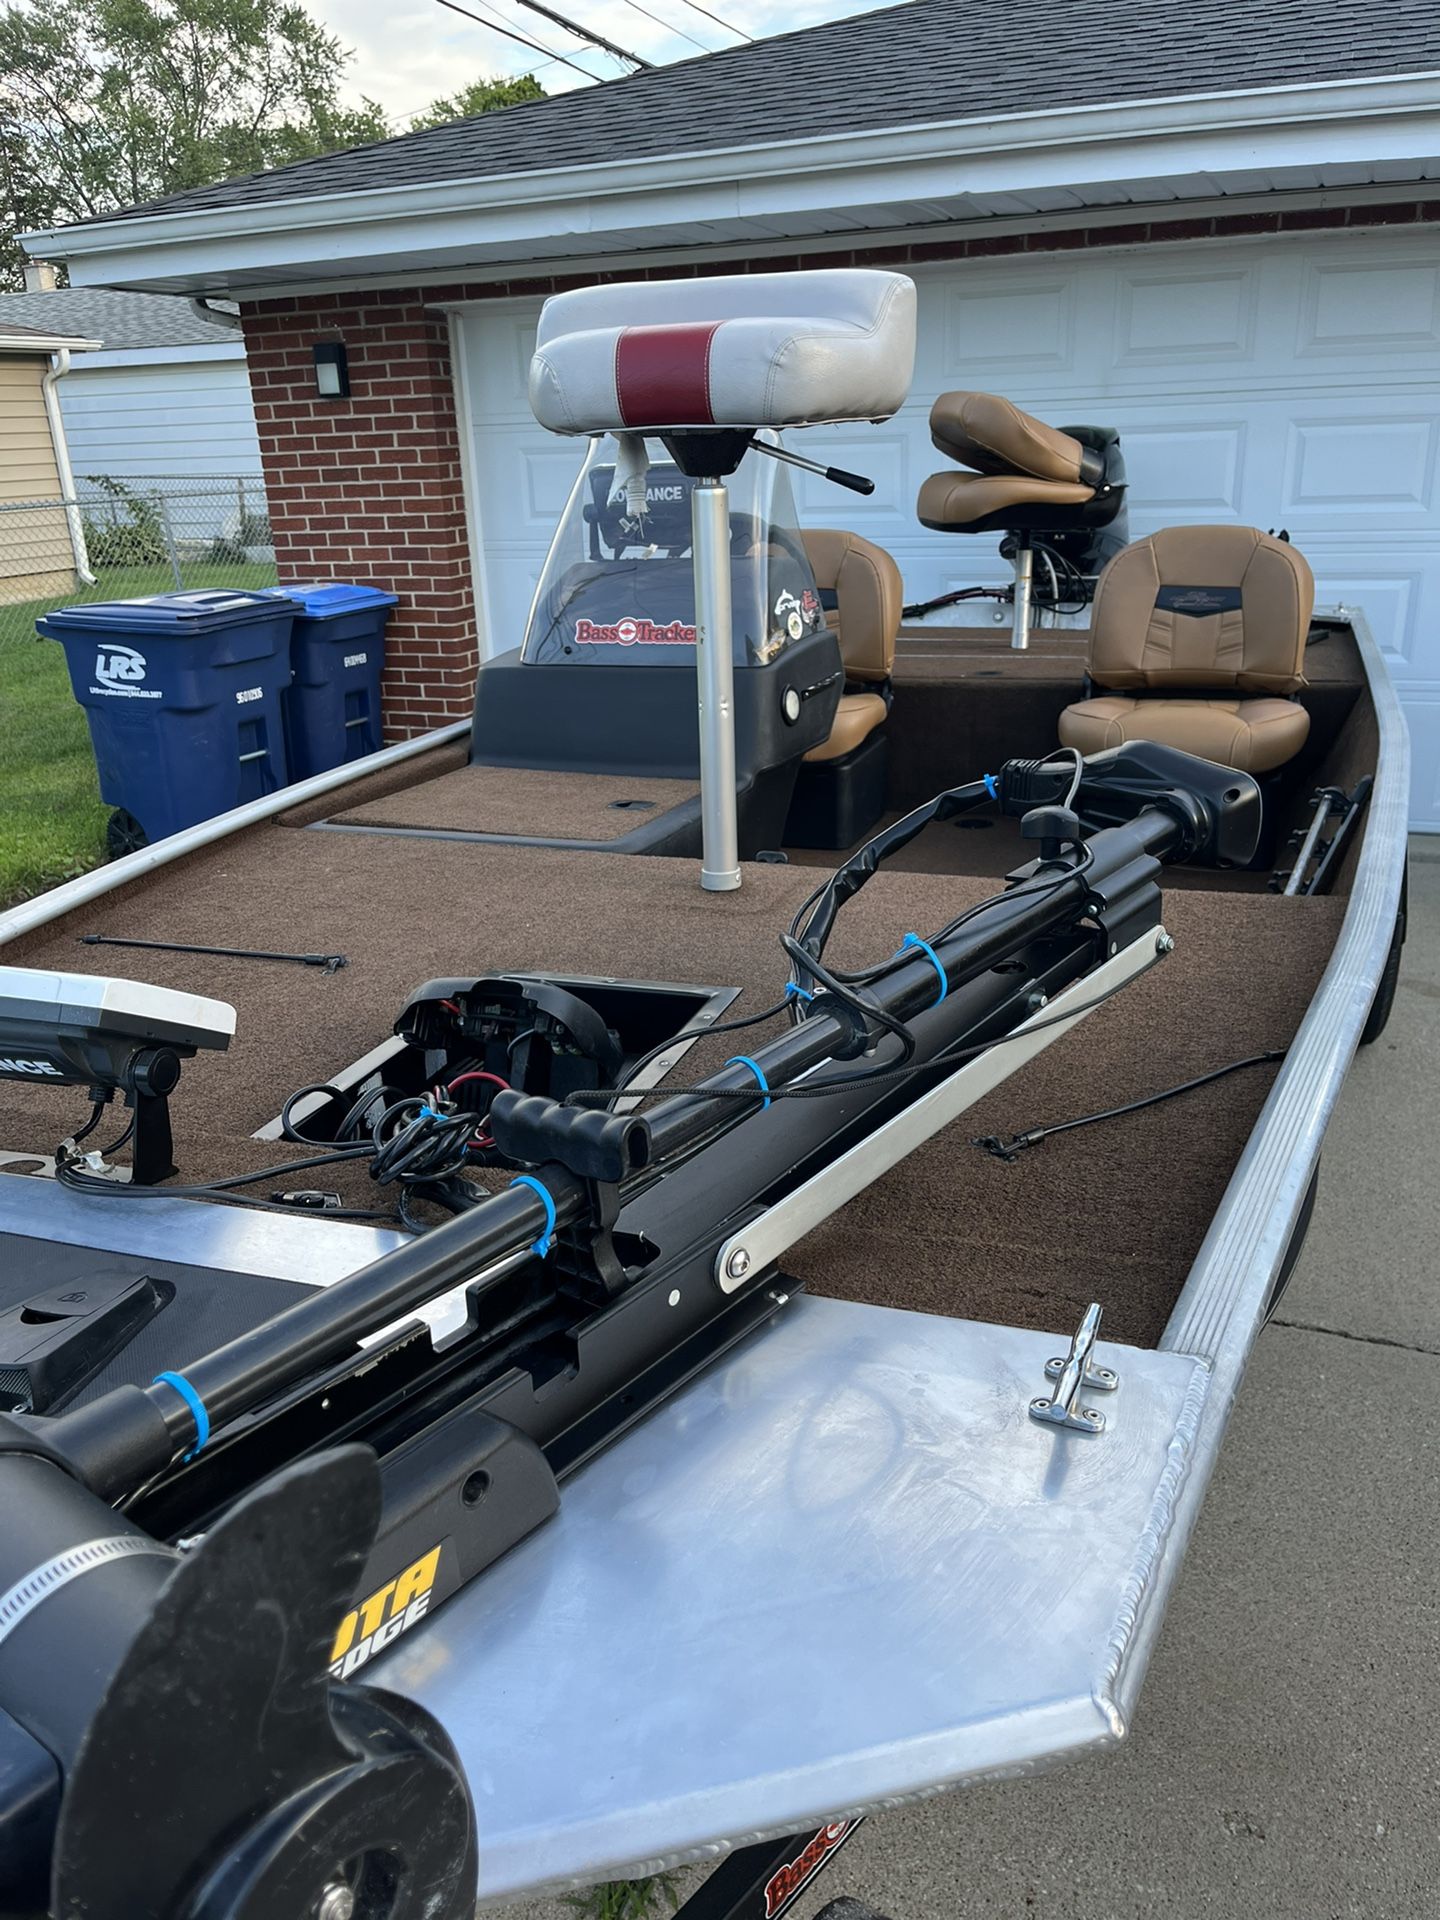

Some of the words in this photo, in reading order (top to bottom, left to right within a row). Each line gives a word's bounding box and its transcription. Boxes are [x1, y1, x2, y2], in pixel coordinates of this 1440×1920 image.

[612, 486, 683, 502] OANCE
[577, 620, 617, 641] Bass
[96, 654, 146, 680] LRS
[0, 1058, 64, 1076] NCE
[765, 1832, 829, 1918] Bass
